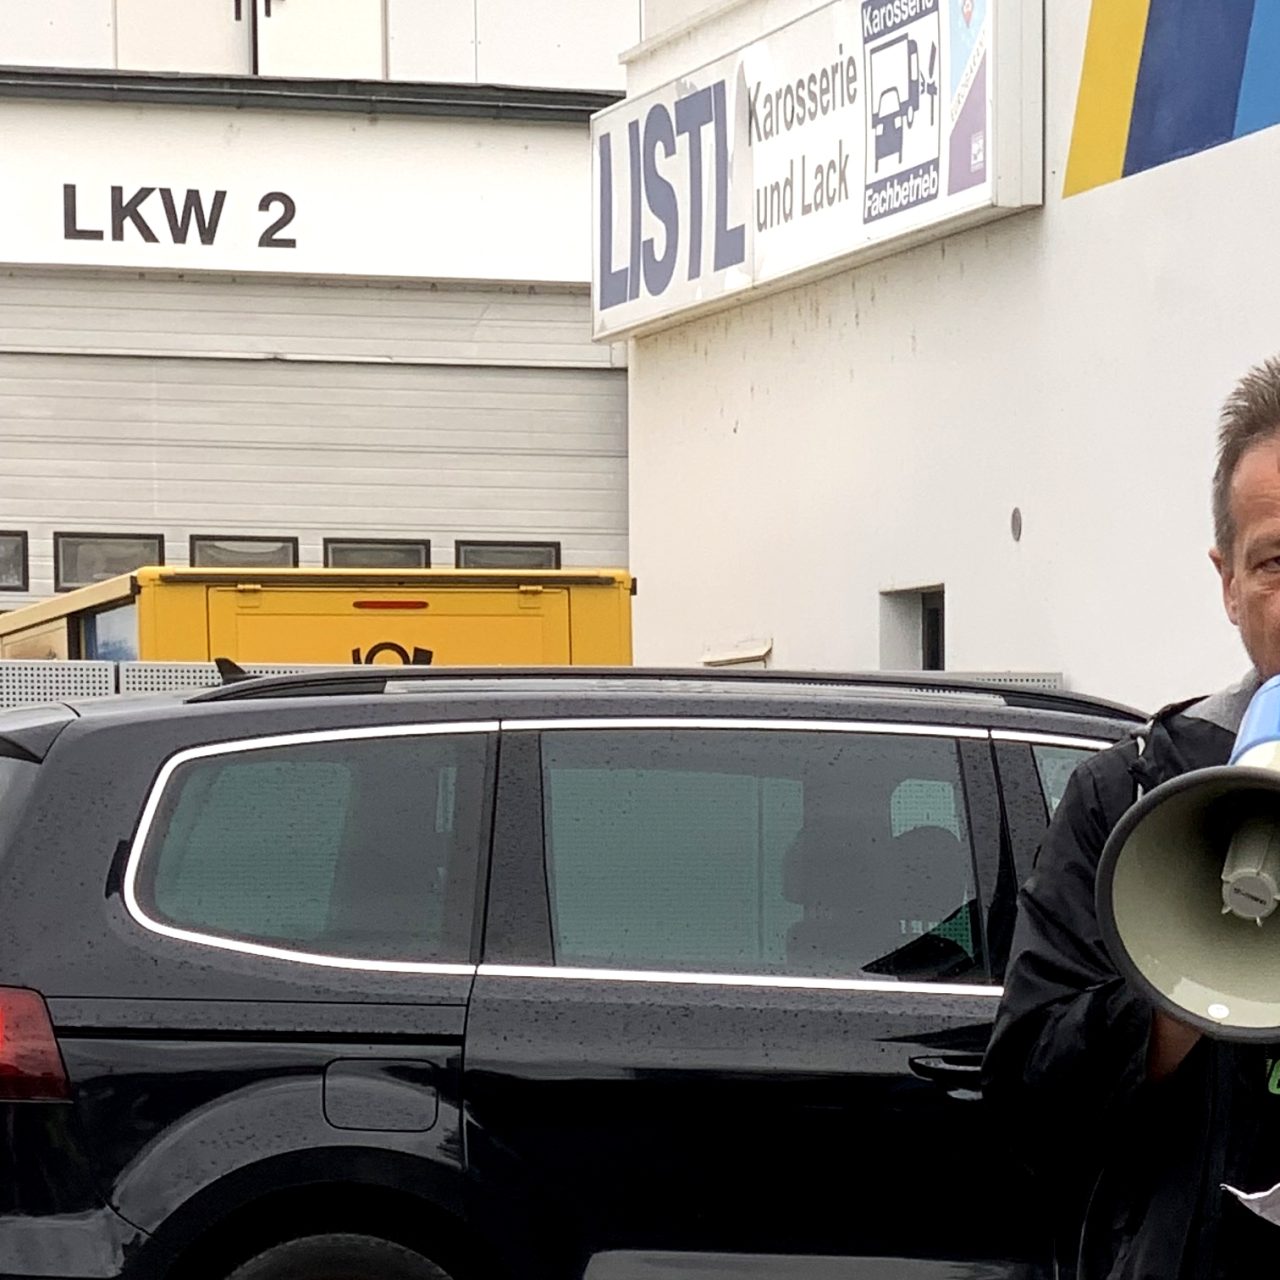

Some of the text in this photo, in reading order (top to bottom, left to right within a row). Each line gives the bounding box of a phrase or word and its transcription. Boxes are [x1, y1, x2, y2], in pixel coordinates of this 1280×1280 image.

[748, 43, 857, 147] Karosserie
[63, 184, 297, 248] LKW 2
[600, 79, 745, 311] LISTL
[756, 139, 849, 232] und Lack
[865, 164, 938, 218] Fachbetrieb
